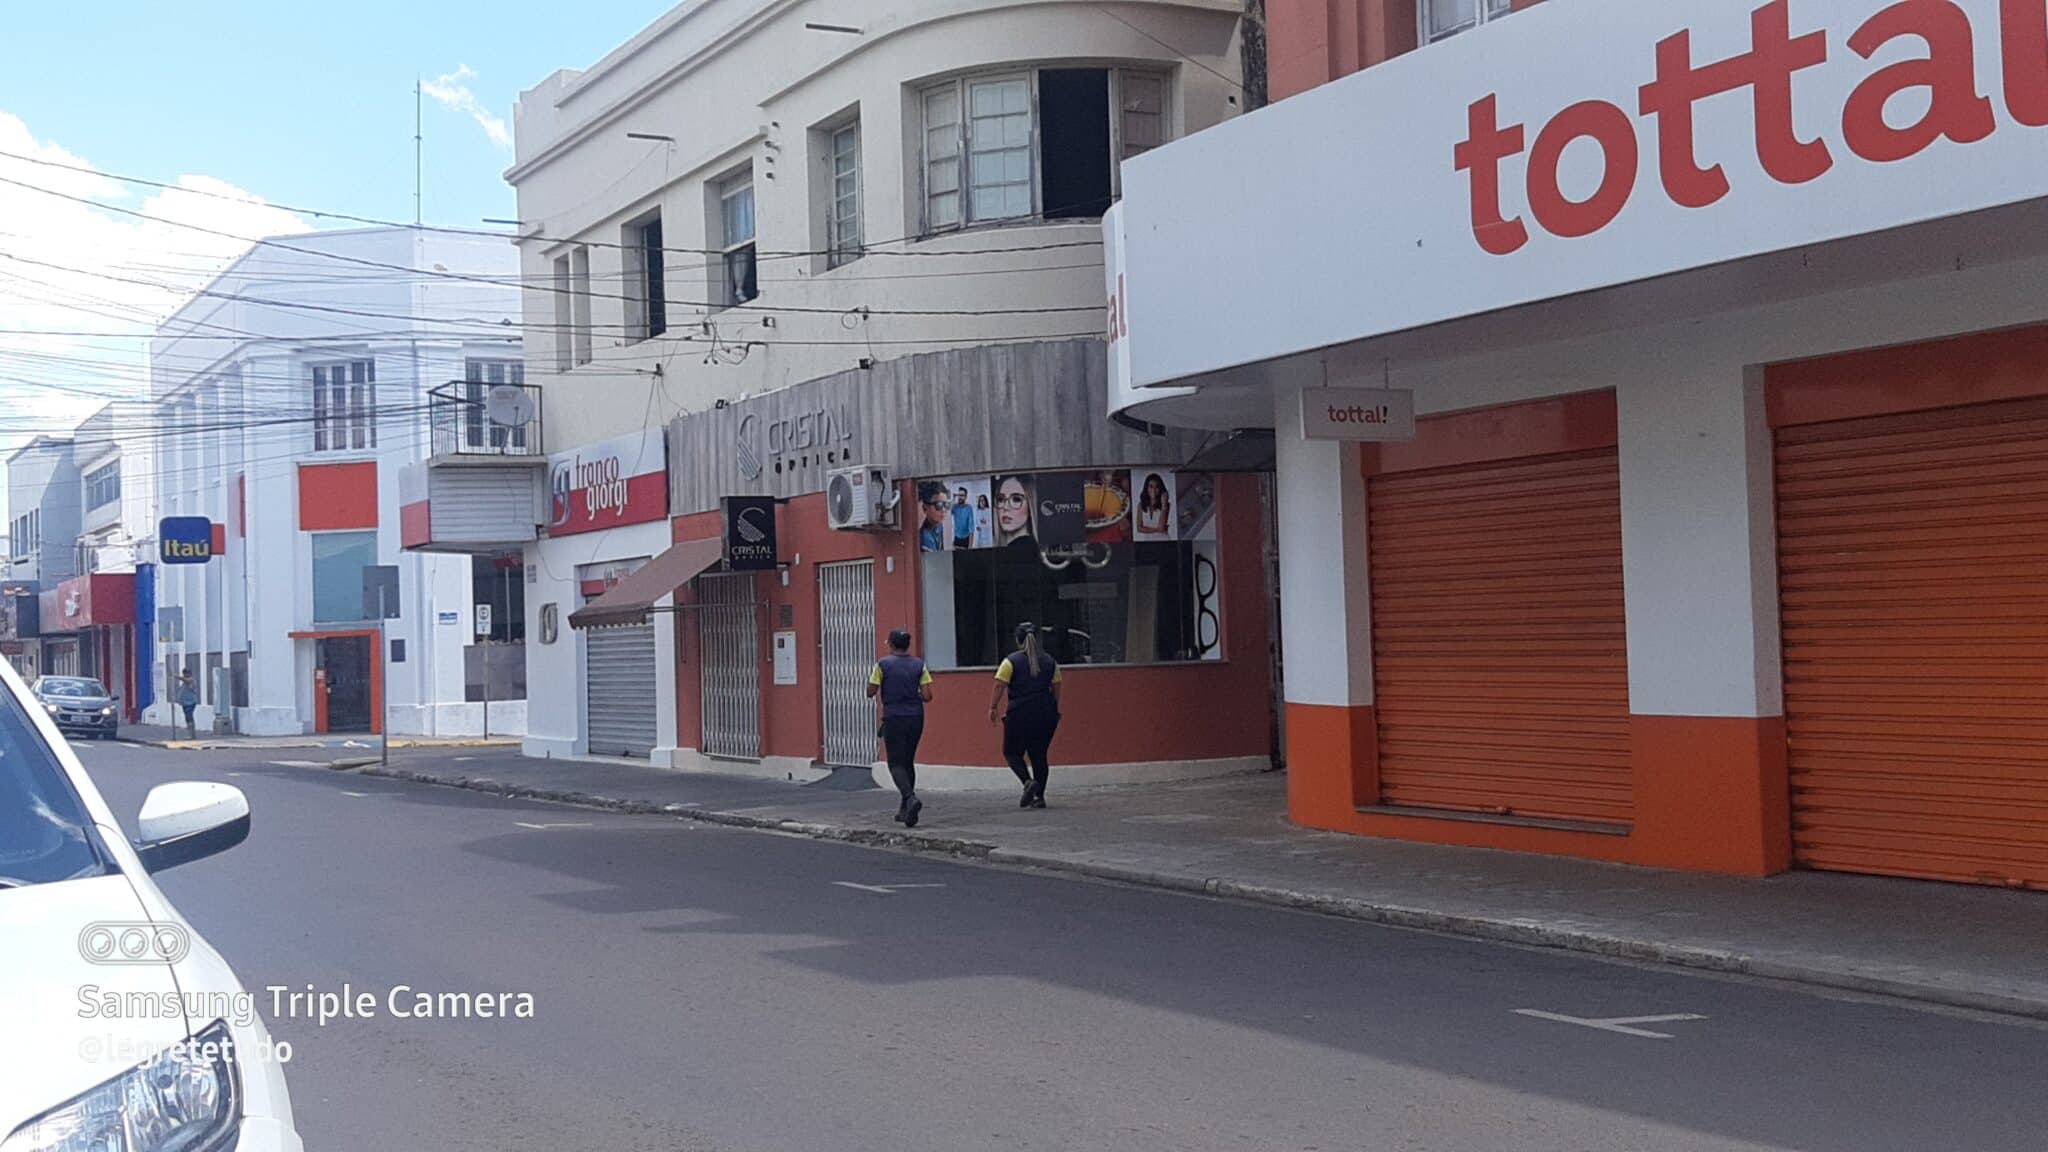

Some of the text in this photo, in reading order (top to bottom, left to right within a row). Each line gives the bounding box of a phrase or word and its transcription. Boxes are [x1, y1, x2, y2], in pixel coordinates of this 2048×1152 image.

[1328, 404, 1389, 424] tottal!
[769, 403, 852, 457] CRISTAL
[576, 454, 619, 488] franco
[586, 477, 628, 521] giorgi
[165, 539, 209, 557] Itaú
[731, 545, 772, 556] CRISTAL
